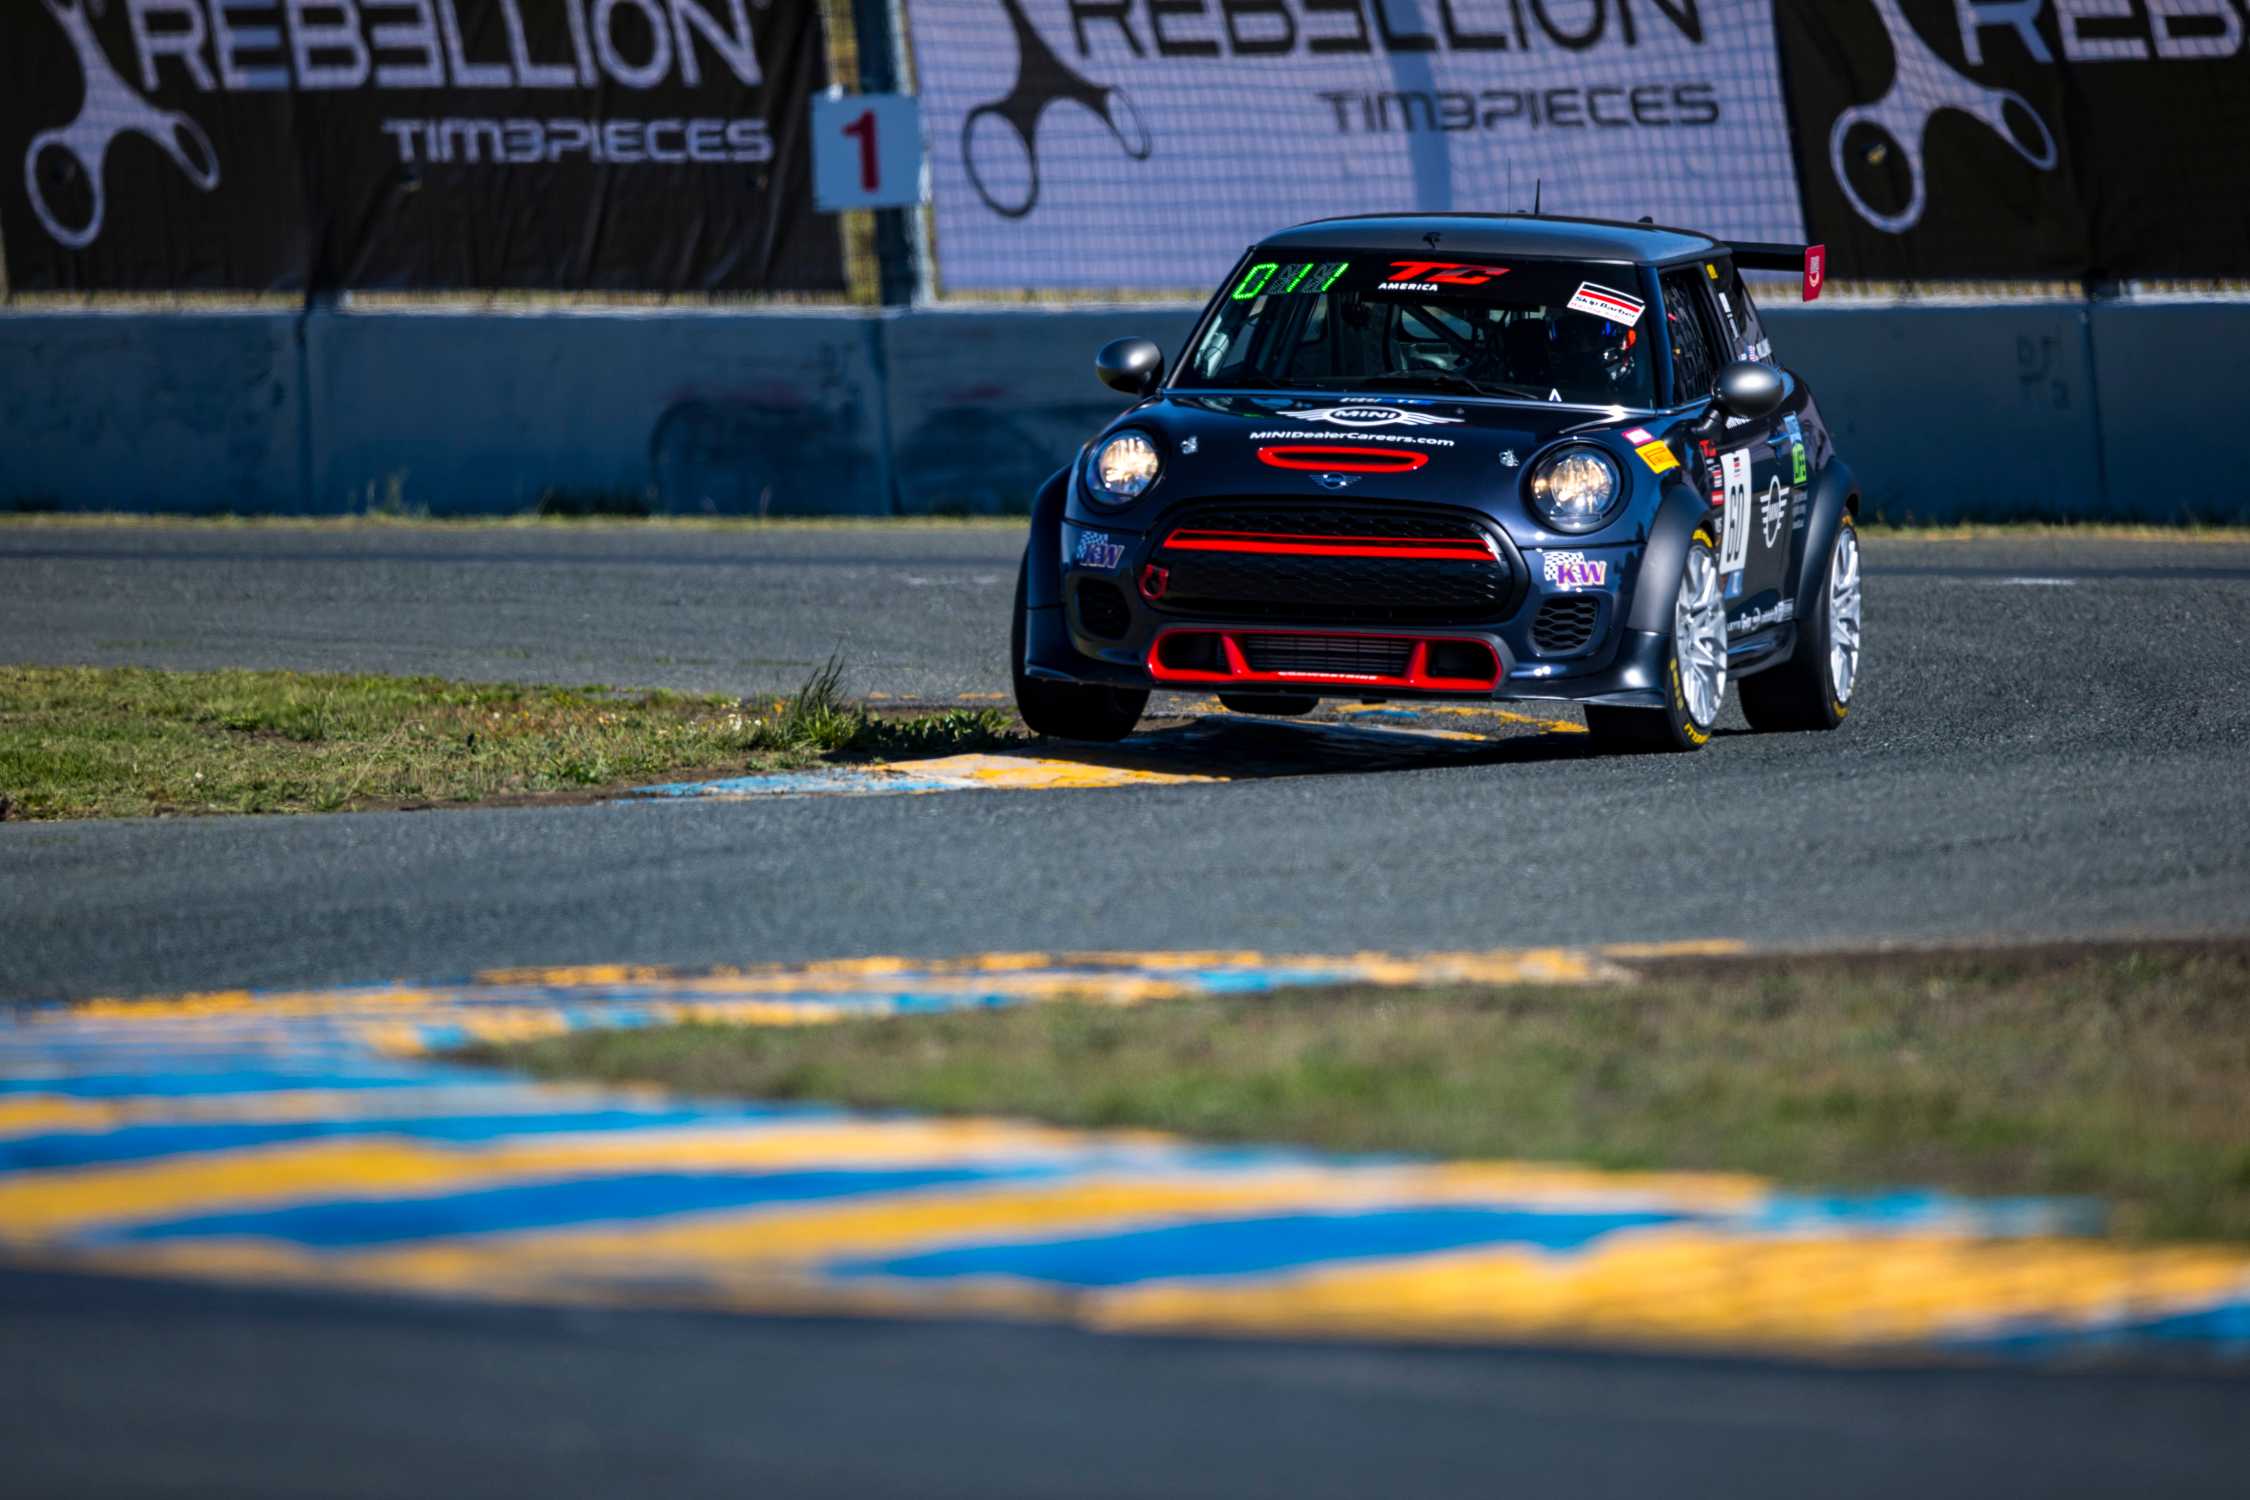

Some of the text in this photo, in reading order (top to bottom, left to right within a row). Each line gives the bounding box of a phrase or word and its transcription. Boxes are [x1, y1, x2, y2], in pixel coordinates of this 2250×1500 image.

[1953, 0, 2250, 66] REB
[842, 108, 881, 193] 1
[1387, 260, 1511, 285] TC
[1377, 282, 1439, 292] AMERICA
[1333, 409, 1397, 420] MINI
[1249, 430, 1456, 448] MINIDealerCareers.com
[1081, 543, 1126, 569] KW
[1556, 560, 1607, 586] KW
